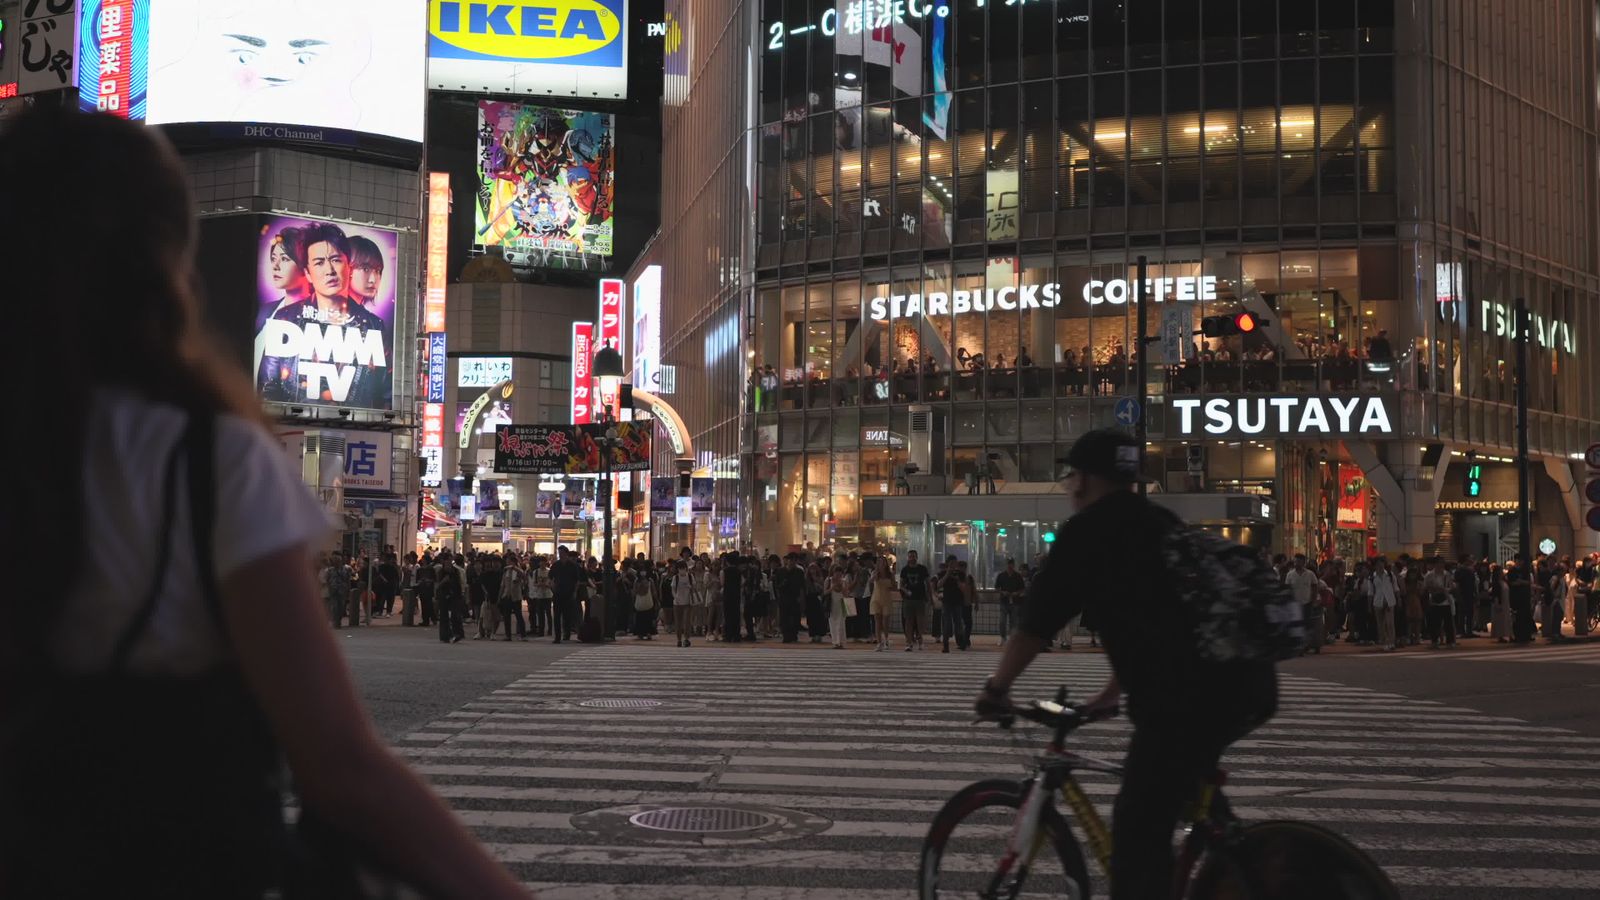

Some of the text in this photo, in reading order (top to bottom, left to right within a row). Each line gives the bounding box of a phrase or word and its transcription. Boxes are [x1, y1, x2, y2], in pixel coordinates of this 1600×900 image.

[440, 1, 606, 41] IKEA
[97, 0, 122, 111] 里薬品
[244, 126, 323, 141] DHC Channel
[870, 283, 1061, 320] STARBUCKS
[264, 318, 387, 366] DMM
[298, 361, 356, 402] TV
[474, 362, 511, 371] れいわ
[1172, 397, 1392, 434] TSUTAYA
[345, 441, 377, 476] 店
[1434, 501, 1492, 509] STARBUCKS
